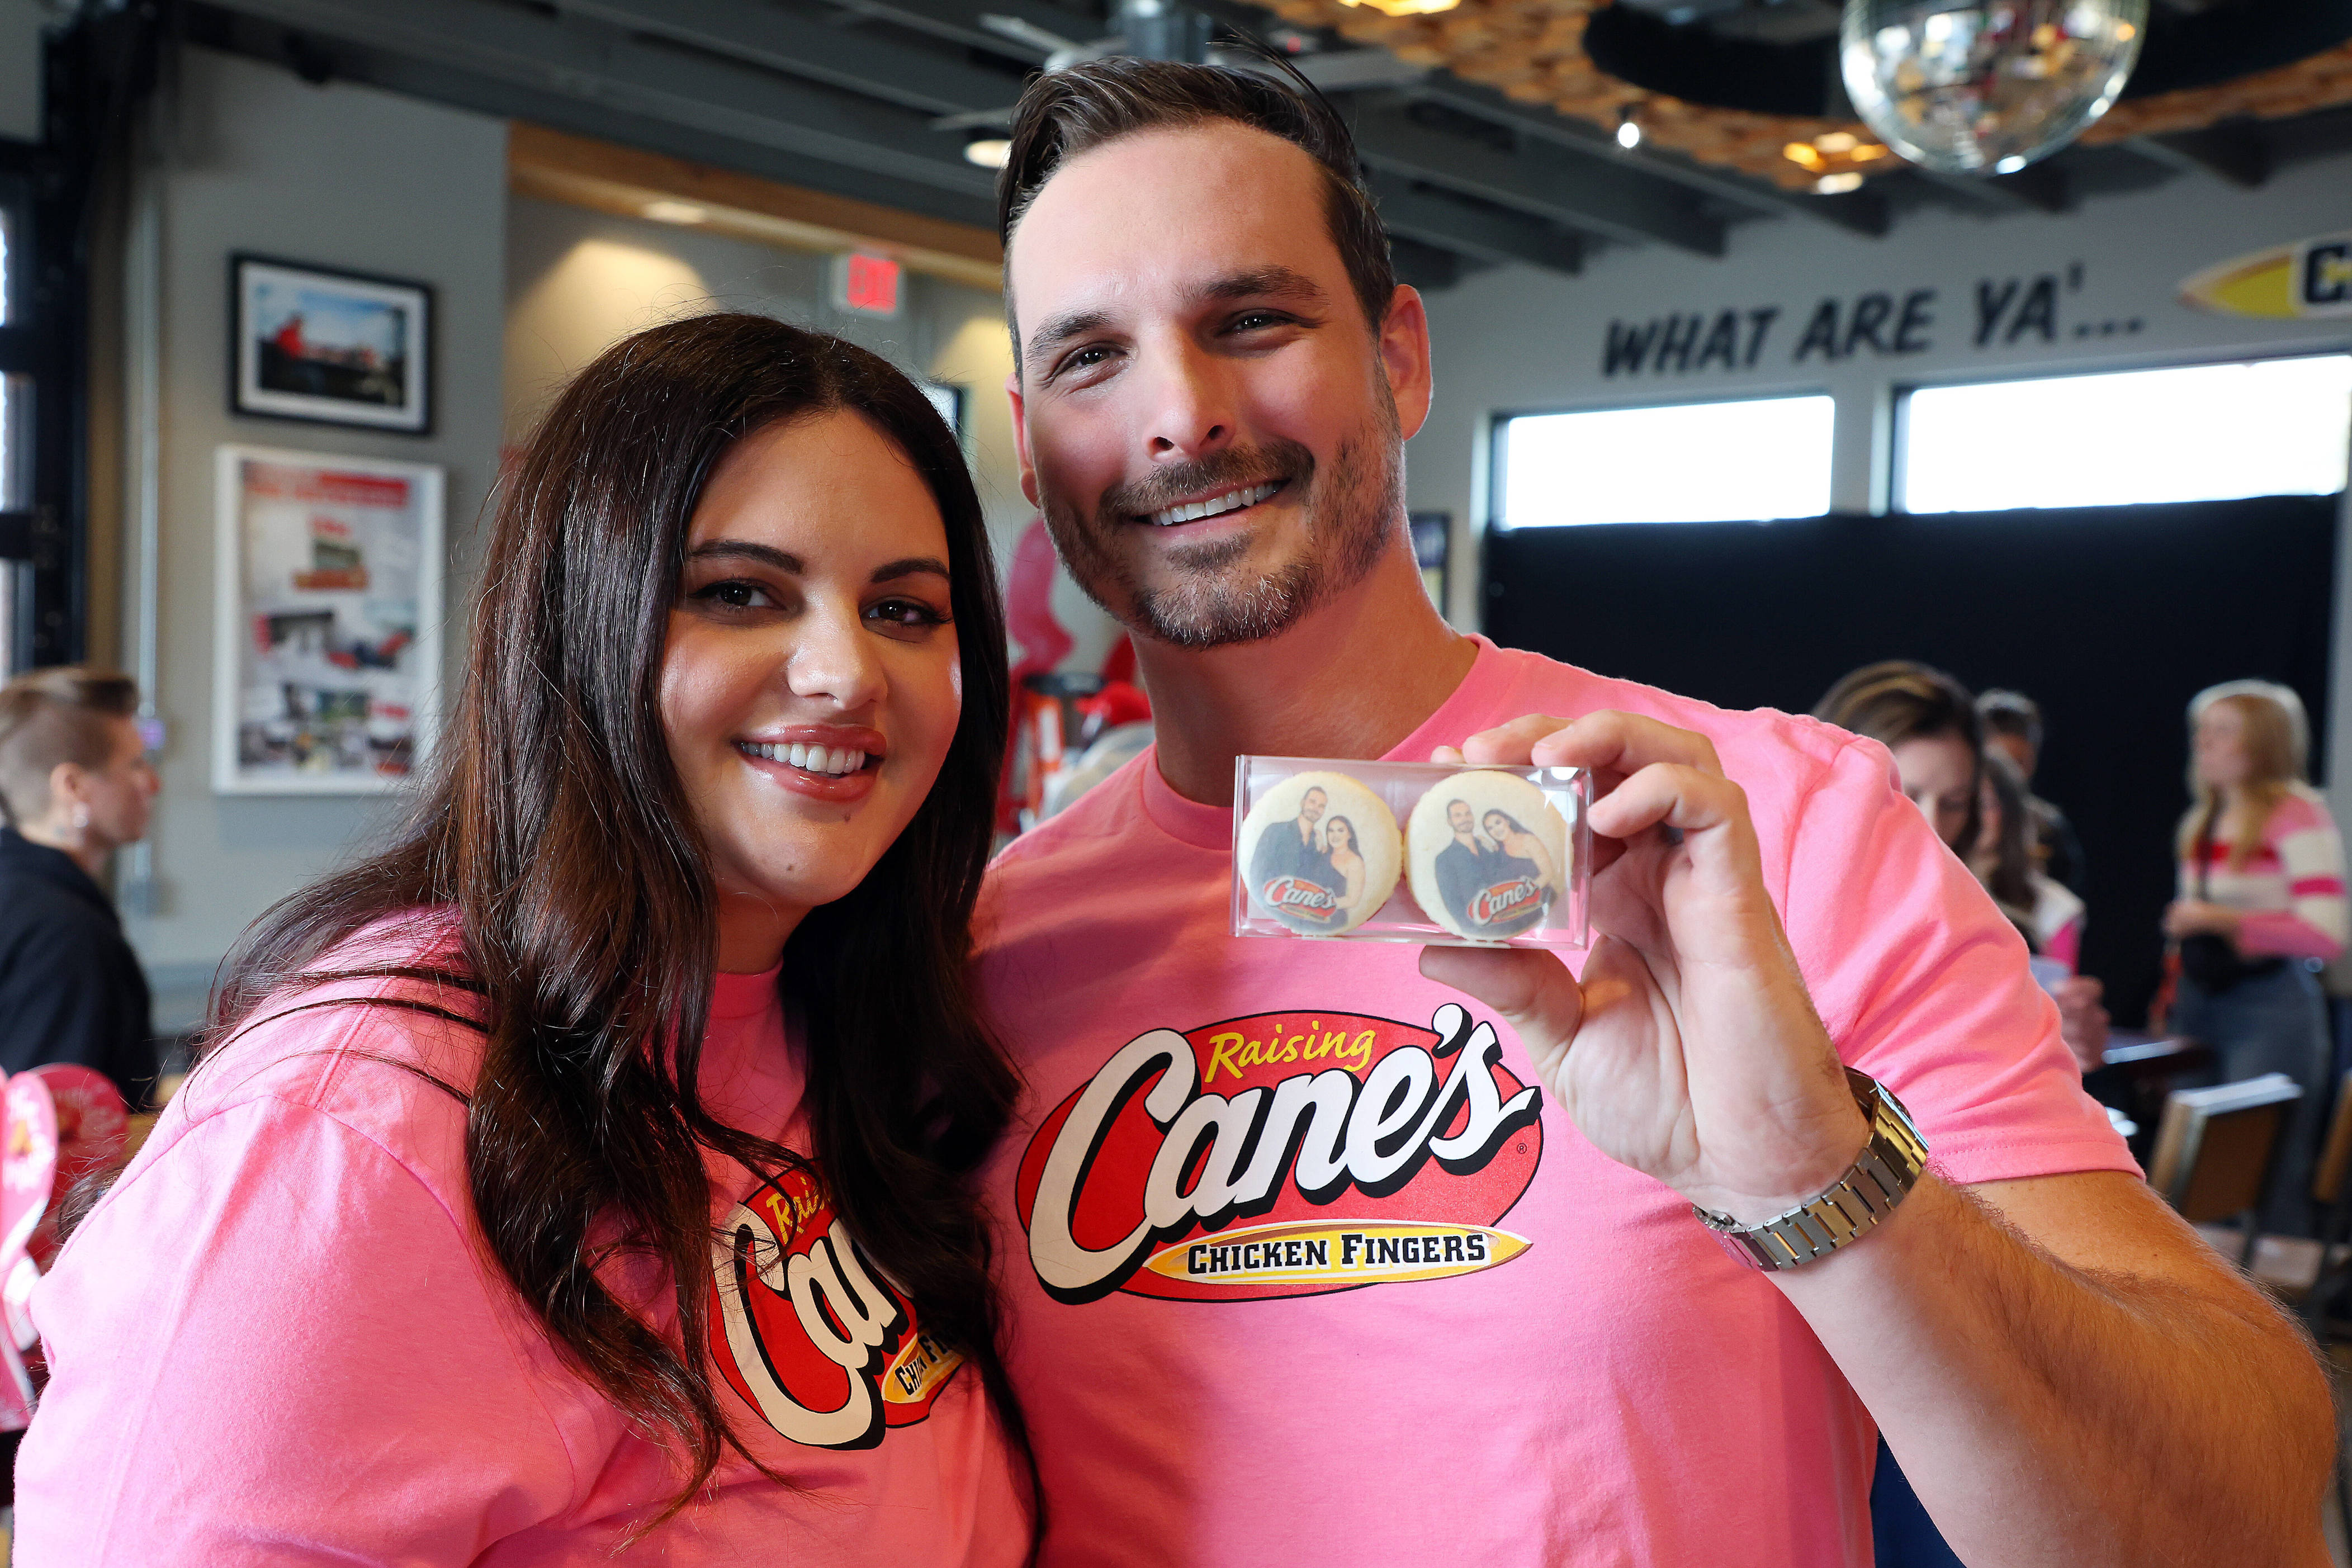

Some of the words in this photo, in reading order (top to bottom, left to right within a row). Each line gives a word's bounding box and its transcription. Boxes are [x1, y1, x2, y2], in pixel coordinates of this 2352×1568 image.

[1603, 305, 1780, 377] WHAT
[1792, 287, 1938, 361] ARE
[1205, 1020, 1376, 1083] Raising
[1028, 1003, 1543, 1304] Cane's
[1187, 1240, 1327, 1275] CHICKEN
[1341, 1234, 1485, 1264] FINGERS
